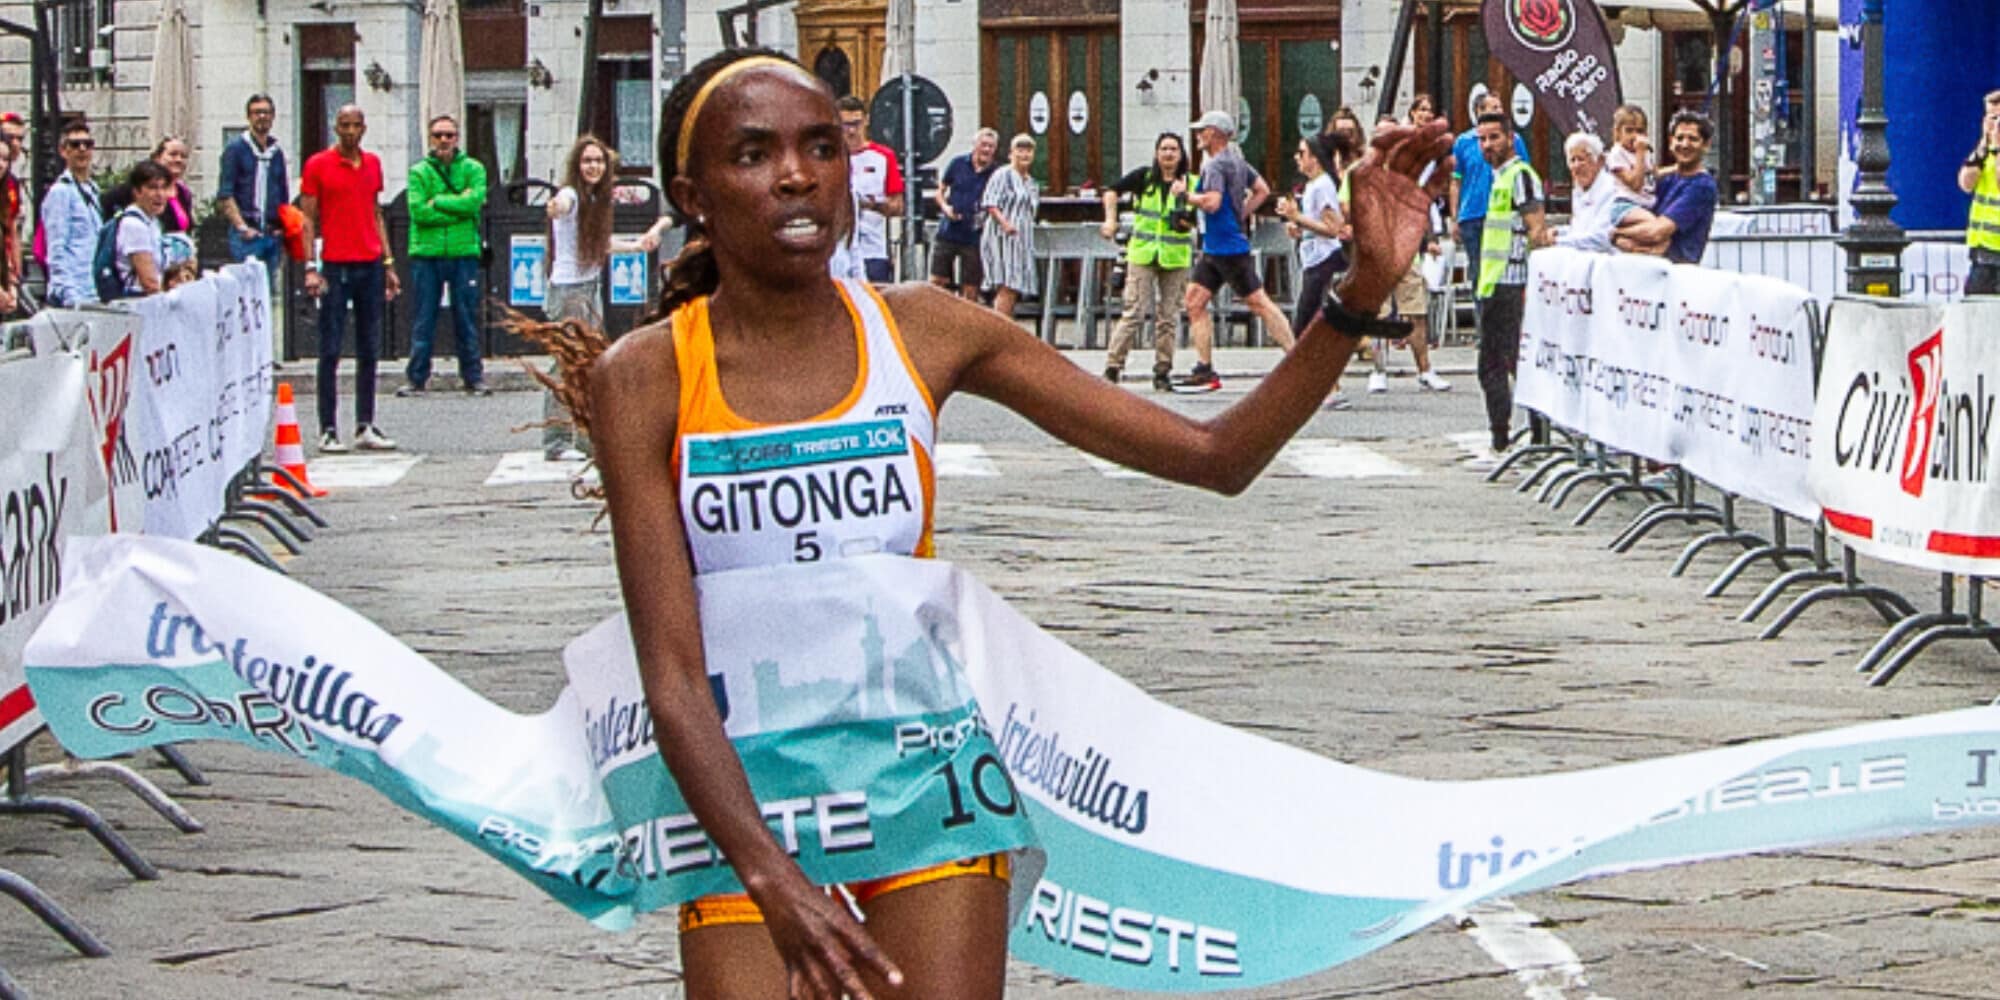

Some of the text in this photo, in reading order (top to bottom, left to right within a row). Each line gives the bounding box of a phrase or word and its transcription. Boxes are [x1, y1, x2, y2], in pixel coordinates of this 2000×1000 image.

[1536, 49, 1578, 93] Radio
[1554, 55, 1598, 98] Punto
[865, 426, 903, 448] 10K
[1835, 328, 1995, 498] CiviBank
[691, 463, 912, 533] GITONGA
[0, 453, 67, 626] ank
[793, 530, 822, 562] 5
[999, 702, 1148, 834] triestevillas
[1026, 880, 1242, 976] RIESTE
